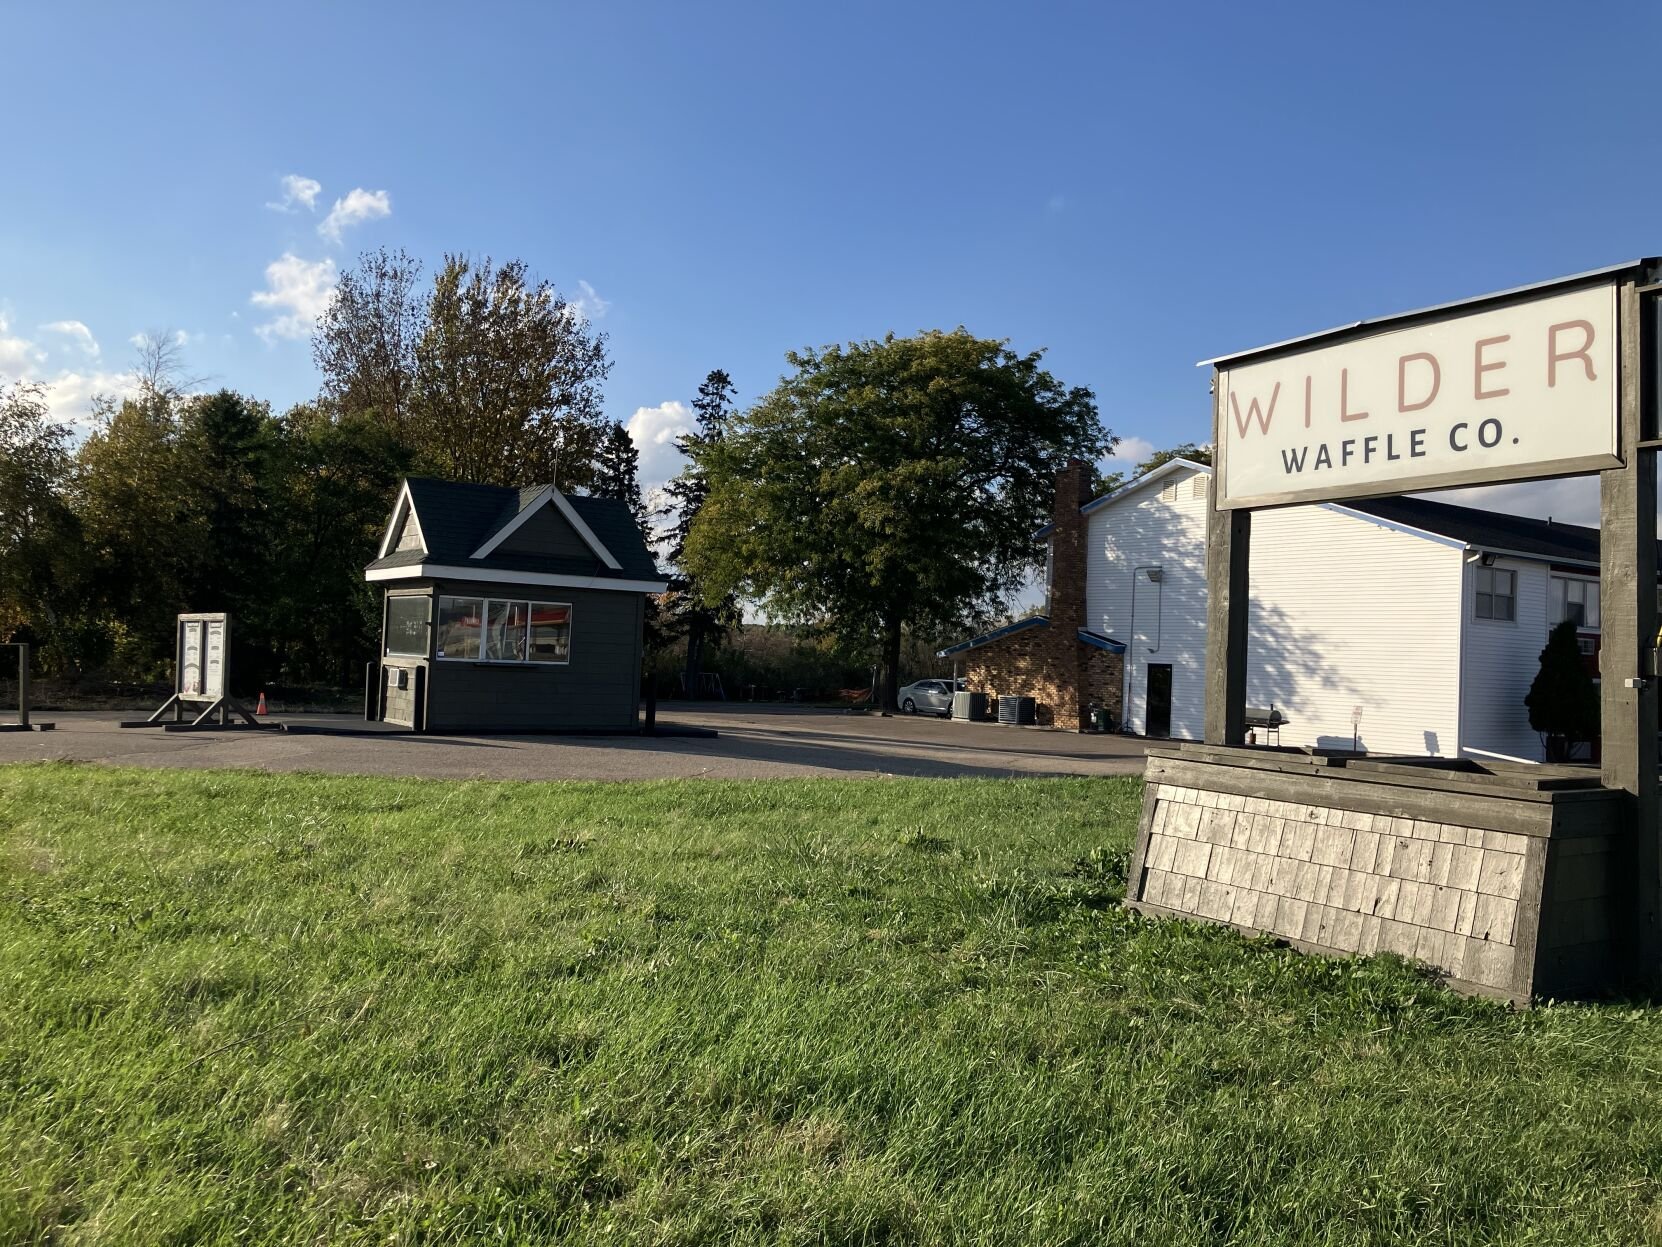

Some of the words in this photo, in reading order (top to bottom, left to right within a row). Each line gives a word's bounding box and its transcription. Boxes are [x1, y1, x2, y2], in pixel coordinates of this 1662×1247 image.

[1230, 319, 1598, 440] WILDER
[1281, 428, 1427, 475] WAFFLE
[1448, 417, 1520, 452] CO.
